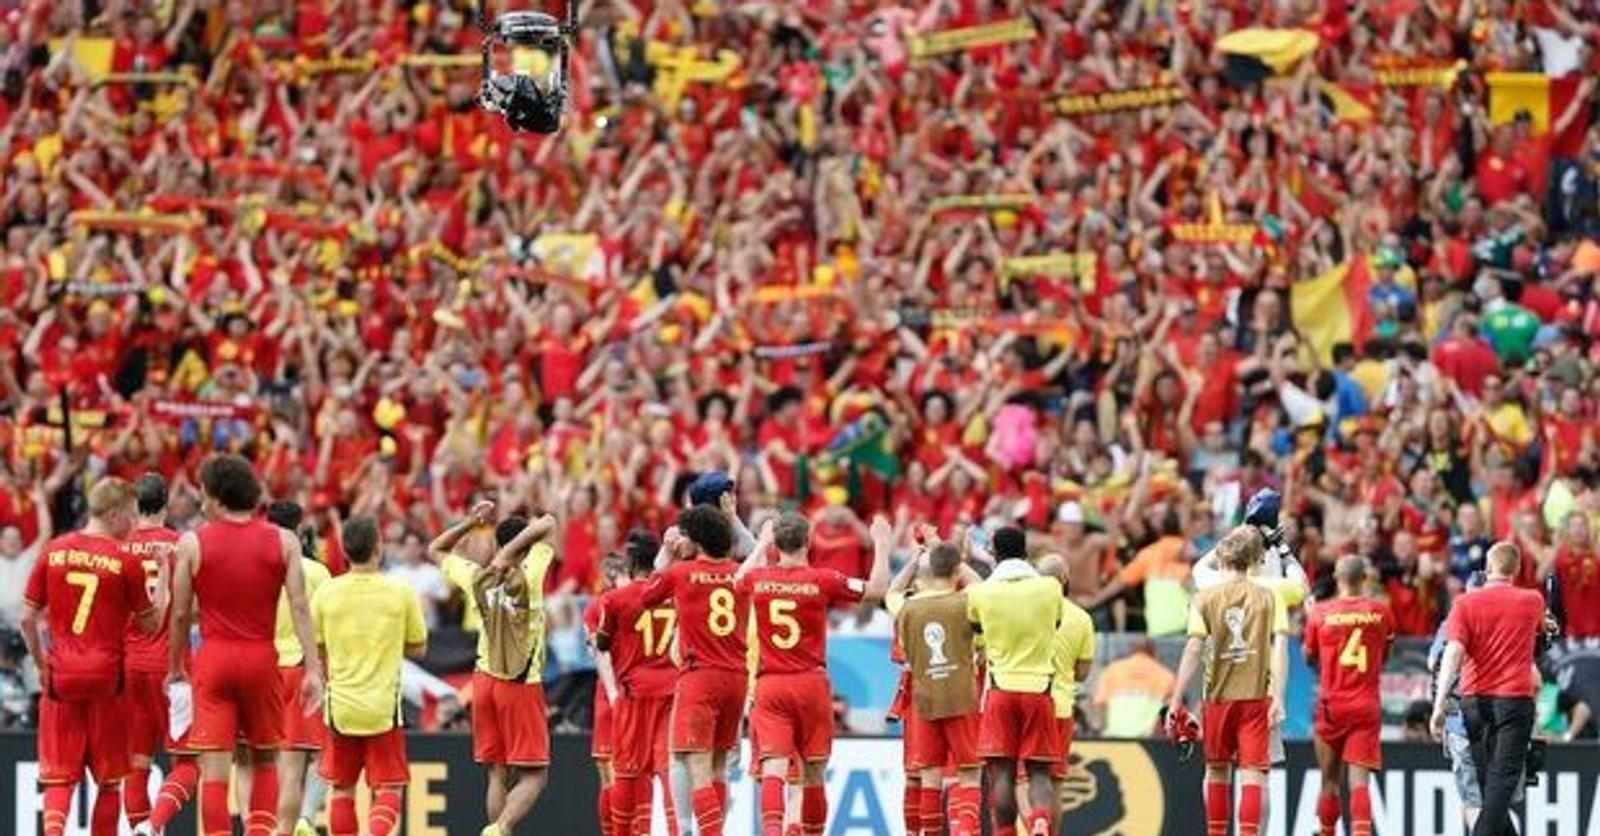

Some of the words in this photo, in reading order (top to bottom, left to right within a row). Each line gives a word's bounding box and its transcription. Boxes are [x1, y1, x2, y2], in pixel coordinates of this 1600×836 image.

[49, 551, 66, 566] DE
[65, 571, 98, 634] 7
[708, 588, 736, 636] 8
[769, 599, 800, 649] 5
[634, 608, 676, 656] 17
[1340, 627, 1367, 673] 4
